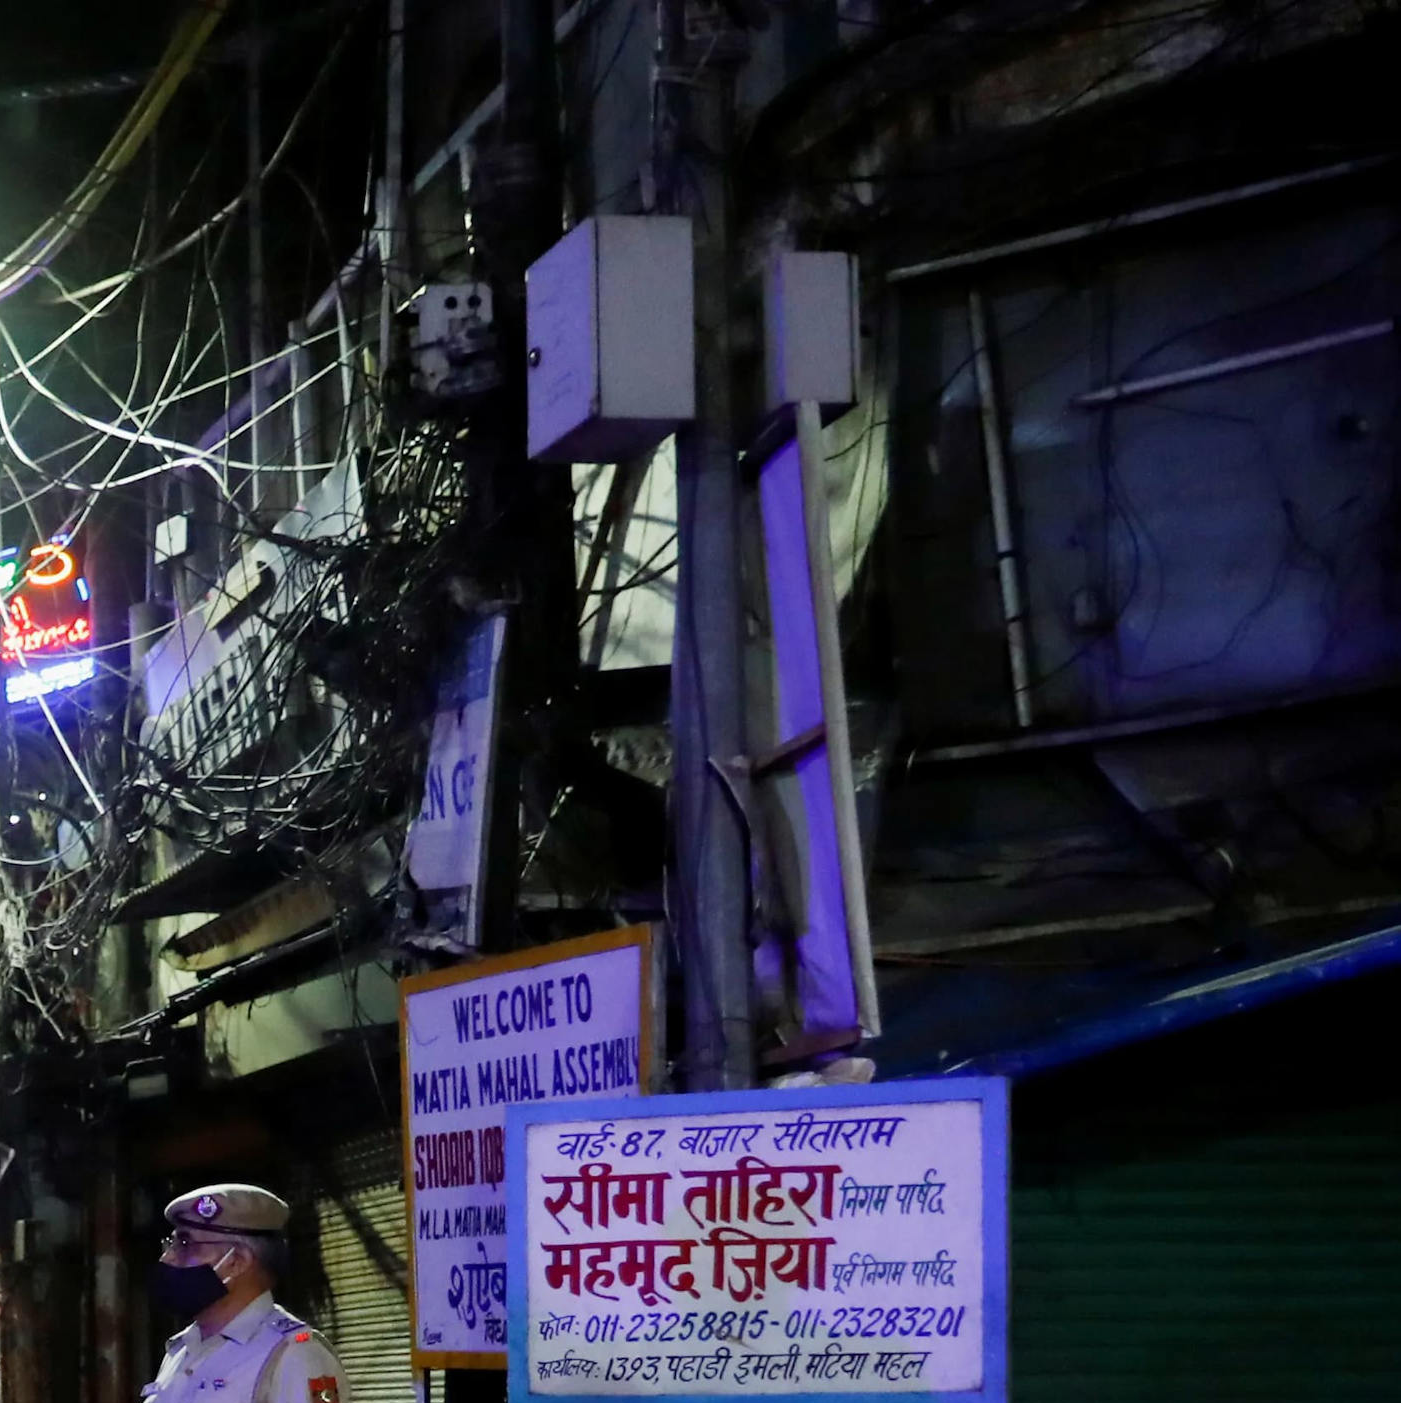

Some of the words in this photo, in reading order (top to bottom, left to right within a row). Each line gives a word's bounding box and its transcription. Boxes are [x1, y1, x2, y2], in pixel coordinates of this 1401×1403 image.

[453, 979, 557, 1044] WELCOME
[561, 972, 593, 1025] TO
[413, 1065, 472, 1116] MATIA
[477, 1053, 546, 1107] MAHAL
[414, 1128, 476, 1190] SHOAIB
[478, 1125, 506, 1192] IQB
[678, 1124, 764, 1158] बाजार
[773, 1112, 907, 1153] सीताराम
[540, 1162, 673, 1236] सीमा
[680, 1156, 843, 1230] ताहिरा
[839, 1177, 895, 1218] निगम
[896, 1168, 947, 1216] पार्षद
[540, 1239, 702, 1307] महमूद
[860, 1253, 907, 1287] निगम
[911, 1250, 958, 1287] पार्षद
[805, 1342, 870, 1380] मटिया
[873, 1351, 933, 1382] महल
